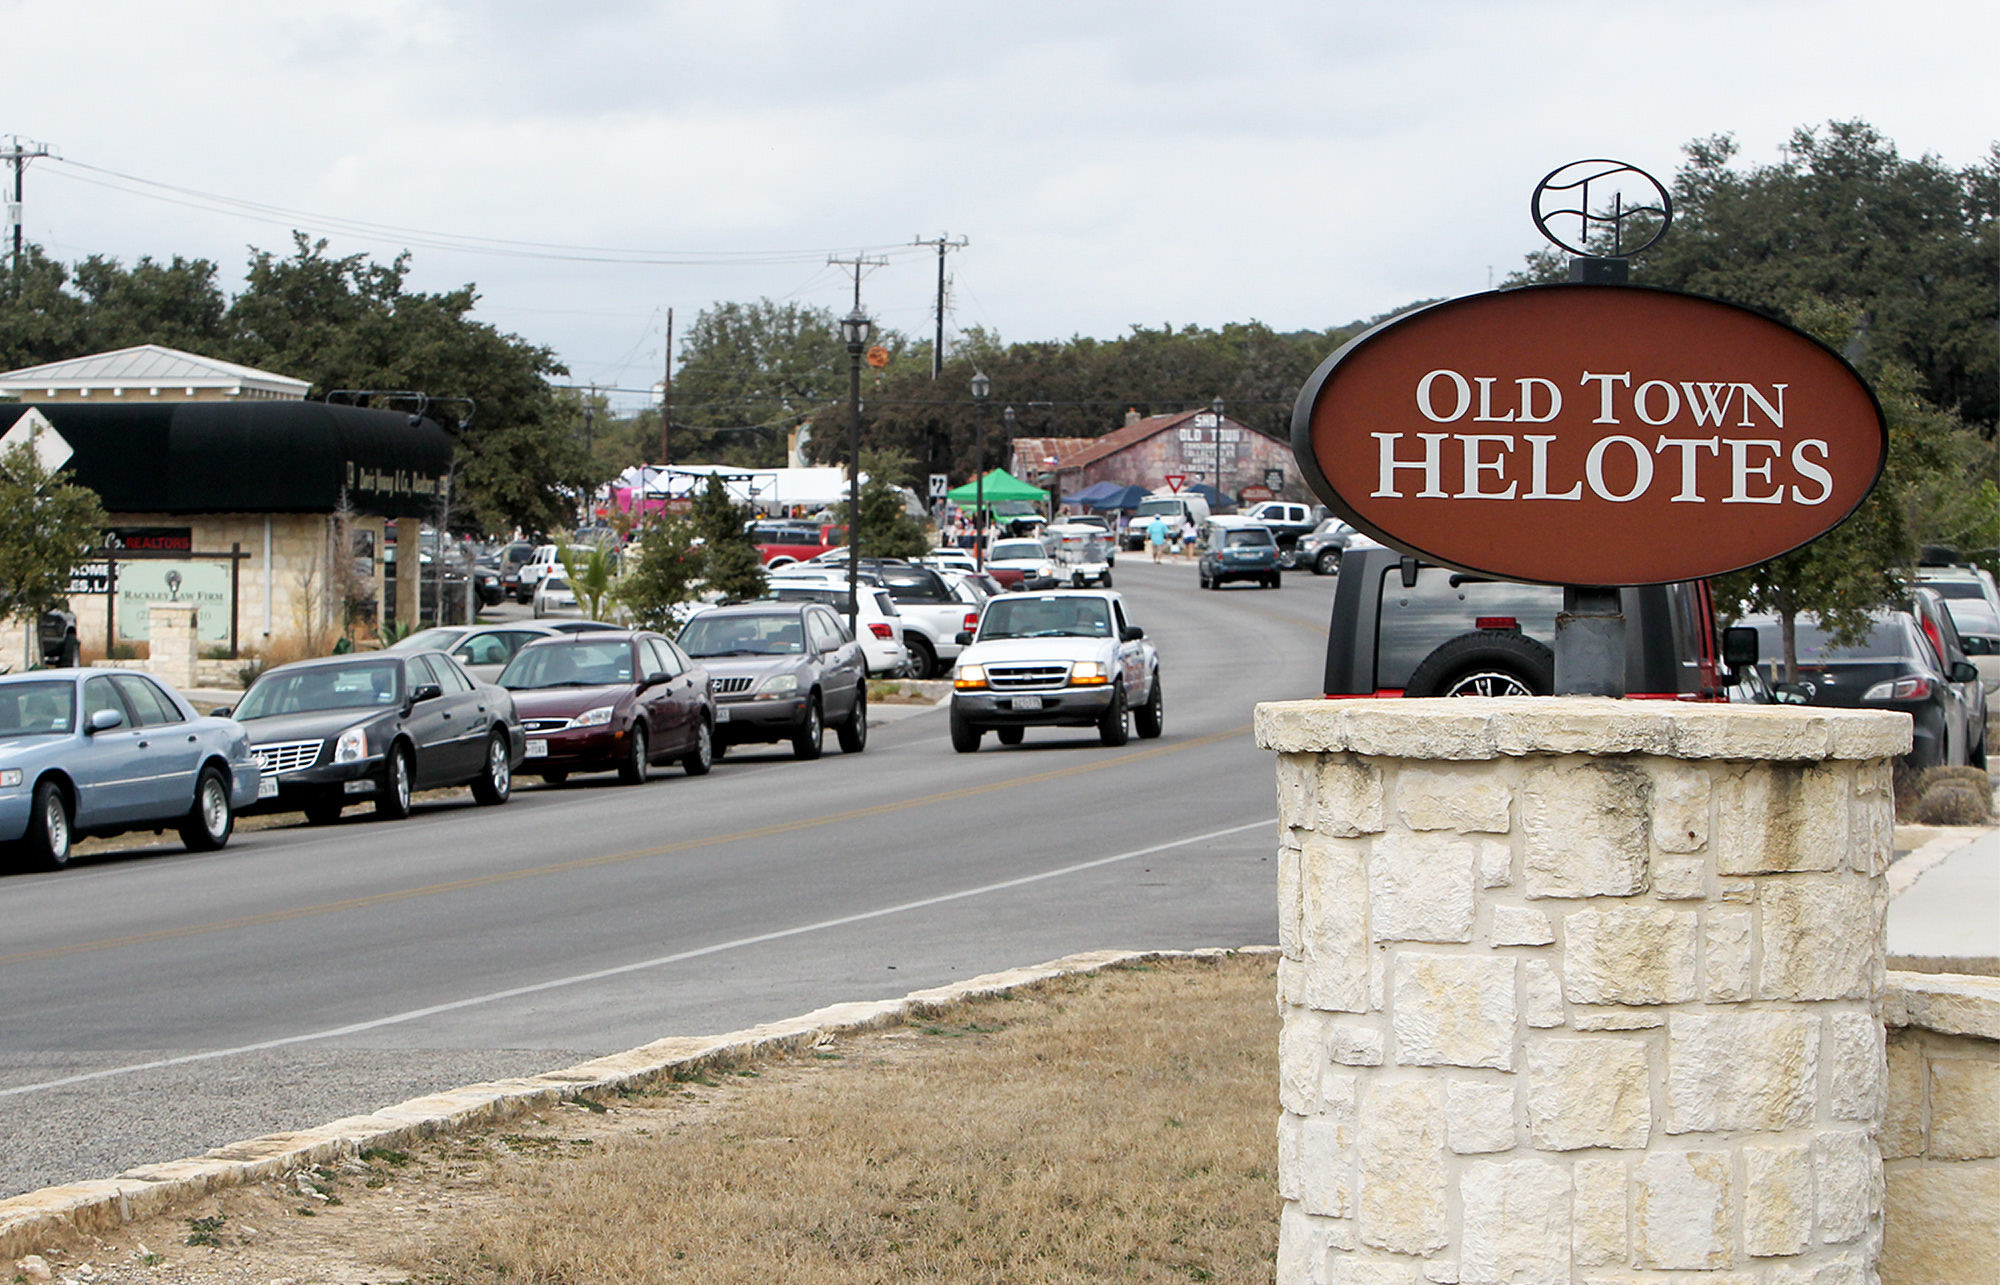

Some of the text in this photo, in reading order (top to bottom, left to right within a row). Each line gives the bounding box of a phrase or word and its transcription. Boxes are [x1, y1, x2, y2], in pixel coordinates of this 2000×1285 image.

[1416, 369, 1788, 428] OLD TOWN
[1180, 429, 1202, 441] OLD
[1370, 432, 1833, 505] HELOTES
[126, 537, 189, 549] REALTORS
[69, 564, 118, 577] HOME
[124, 590, 223, 600] RACKLEY AW FIRM
